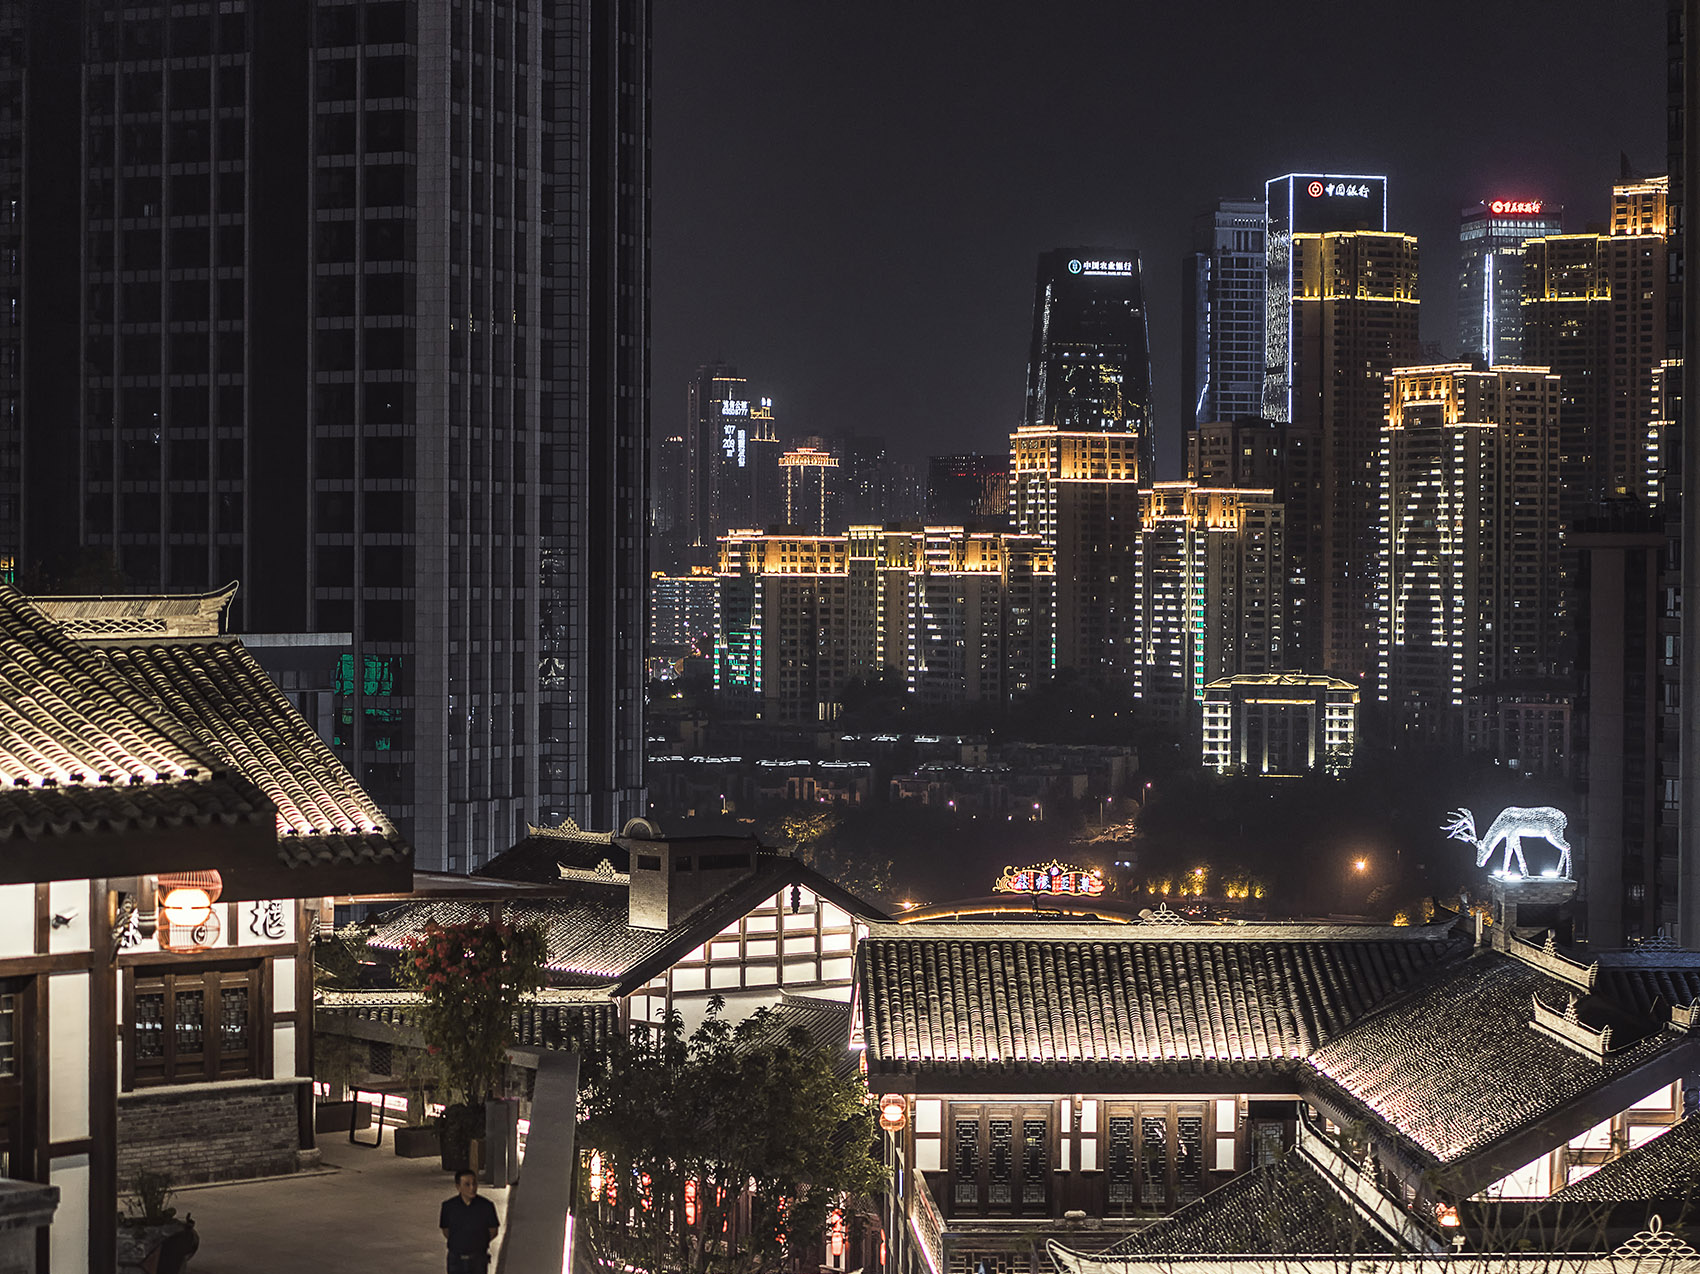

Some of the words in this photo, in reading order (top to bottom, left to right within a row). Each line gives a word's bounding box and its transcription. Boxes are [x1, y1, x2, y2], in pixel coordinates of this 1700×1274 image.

[1325, 183, 1370, 198] 中国银行
[1083, 260, 1132, 271] 中国农业银行
